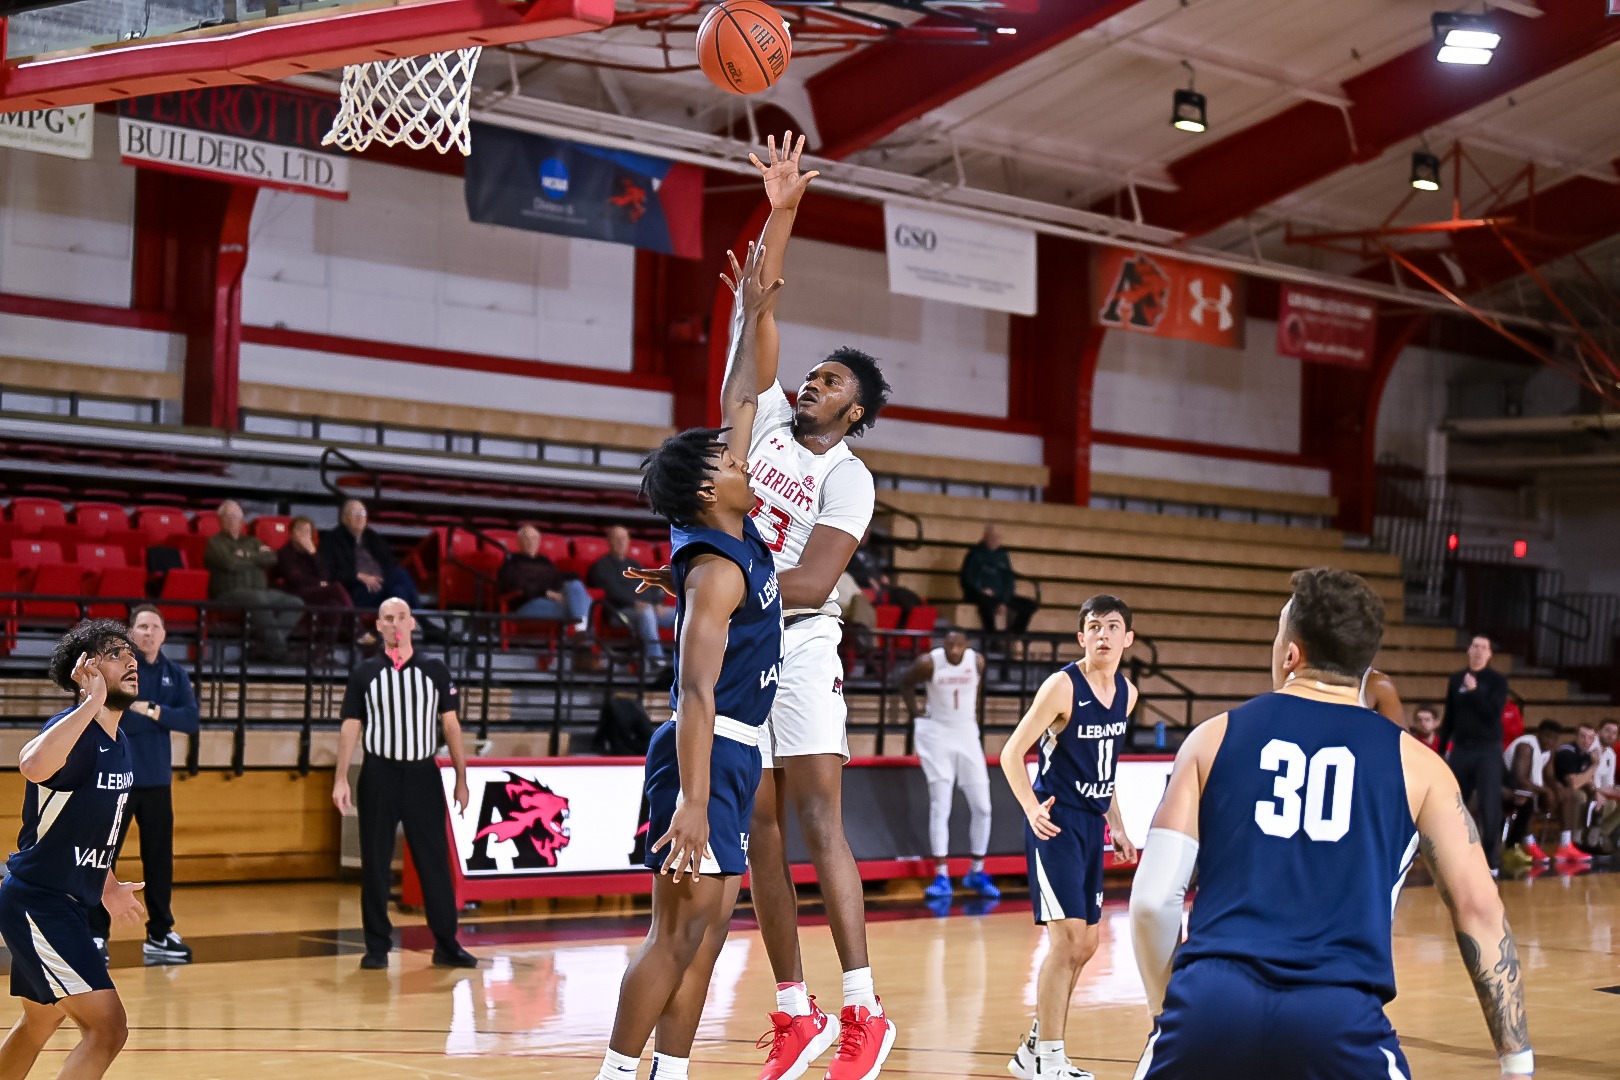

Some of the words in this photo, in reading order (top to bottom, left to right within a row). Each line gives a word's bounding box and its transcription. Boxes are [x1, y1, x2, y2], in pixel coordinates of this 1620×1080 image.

[750, 23, 776, 52] THE
[283, 151, 337, 188] LTD.
[895, 223, 938, 253] GSO
[750, 459, 813, 512] ALBRIGHT
[1077, 722, 1127, 739] LEBANON
[1097, 738, 1114, 781] 11
[96, 771, 134, 790] LEBANO
[1075, 780, 1115, 798] VALLE
[1255, 739, 1356, 842] 30
